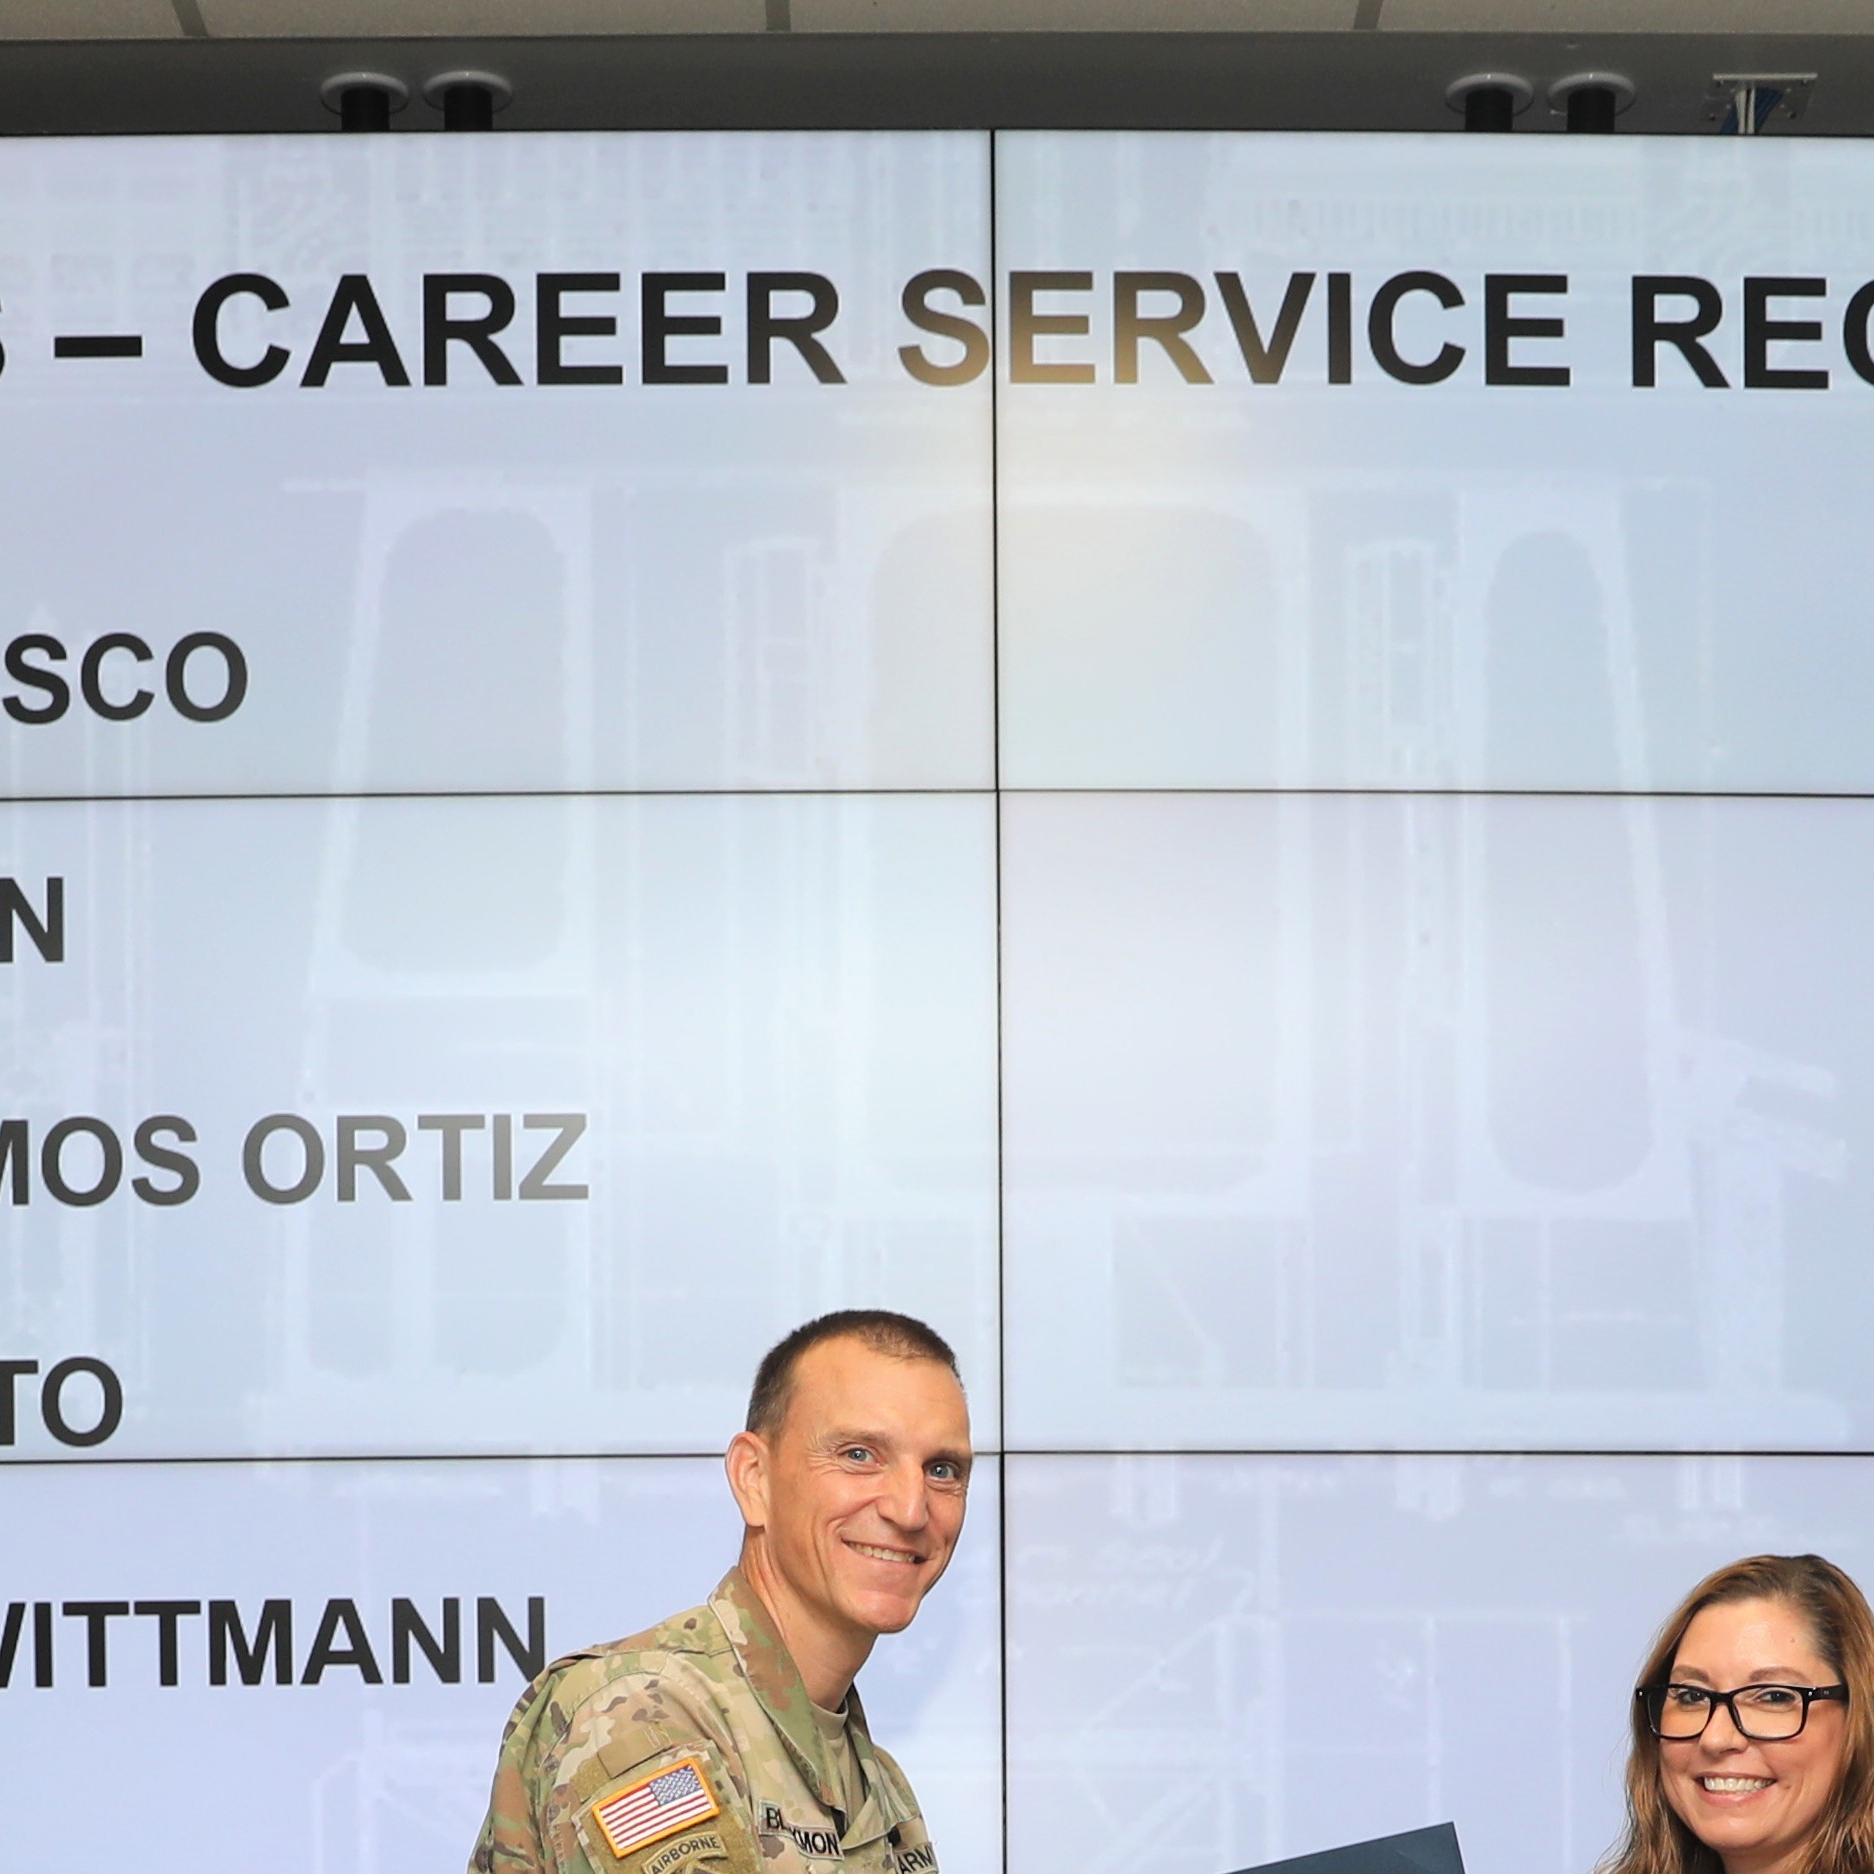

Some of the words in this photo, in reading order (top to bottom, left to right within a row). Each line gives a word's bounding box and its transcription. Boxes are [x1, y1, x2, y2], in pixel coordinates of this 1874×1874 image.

[193, 272, 845, 388] CAREER
[899, 270, 1570, 386] SERVICE
[243, 1112, 589, 1206] ORTIZ
